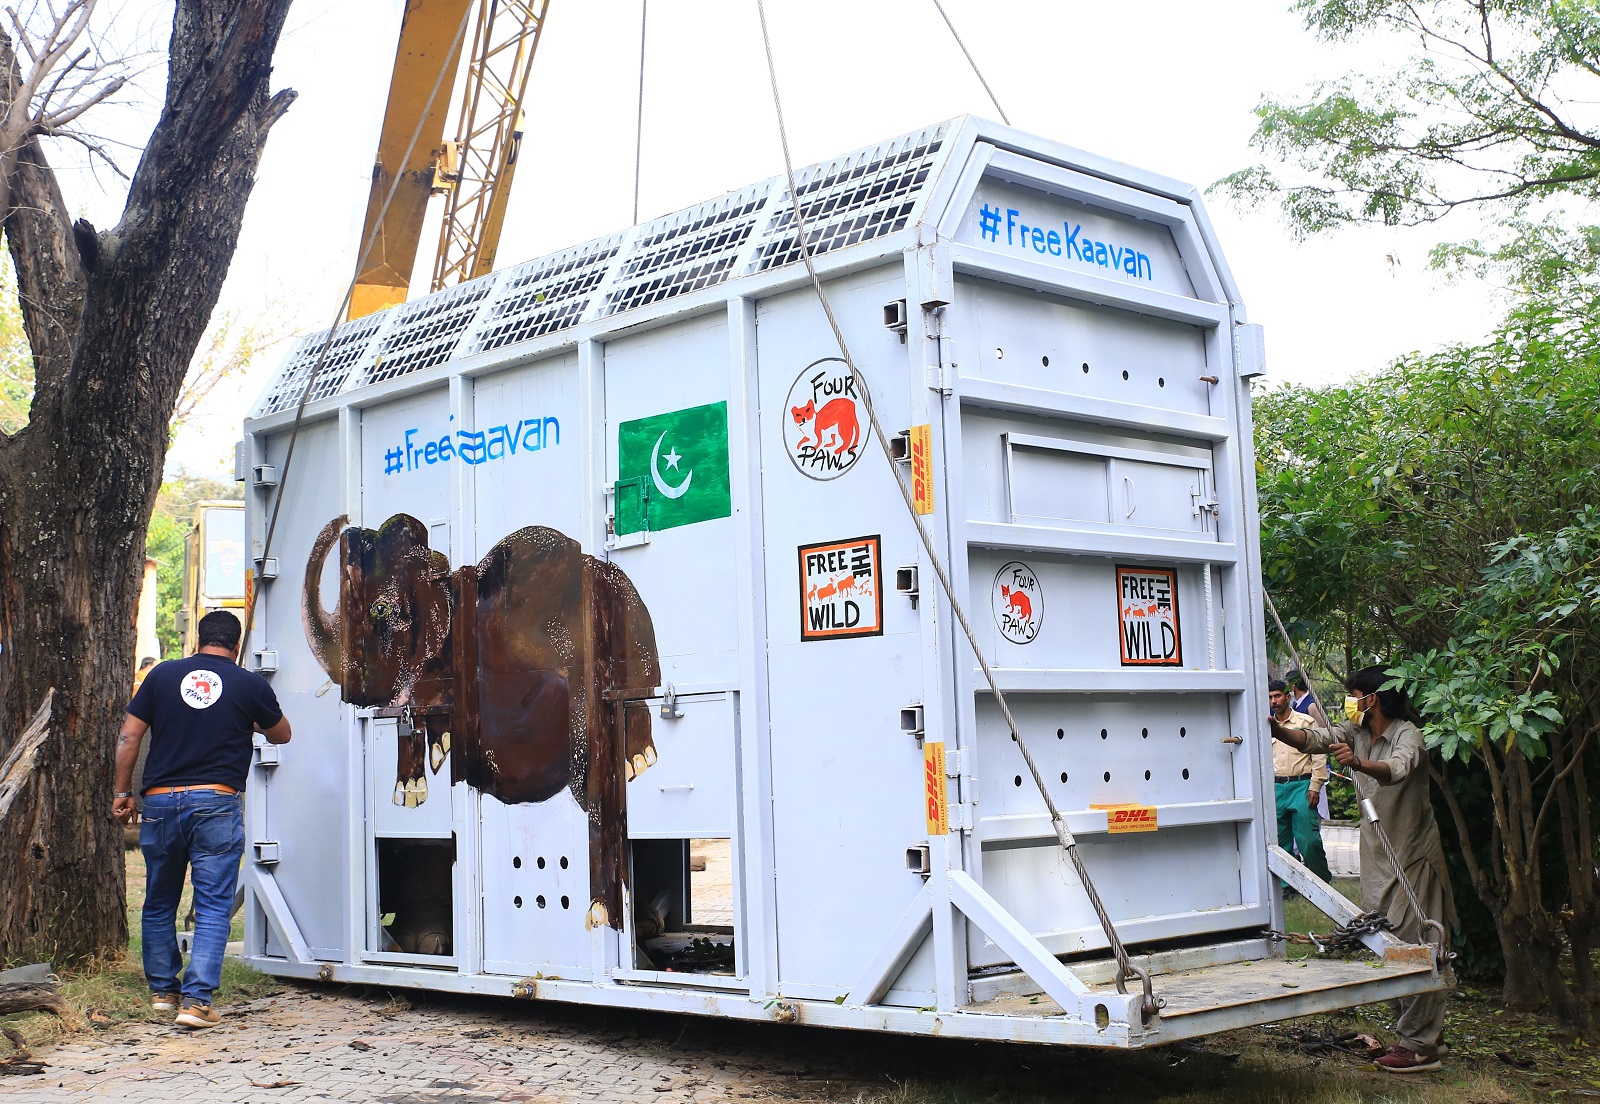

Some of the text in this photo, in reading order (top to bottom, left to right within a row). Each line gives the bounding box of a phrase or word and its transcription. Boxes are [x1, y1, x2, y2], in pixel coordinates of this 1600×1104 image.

[979, 203, 1152, 281] #FreeKaavan
[810, 371, 858, 404] FOUR
[384, 414, 560, 475] #Freeaavan
[797, 445, 859, 471] PAWS
[913, 437, 926, 502] DHL
[807, 550, 848, 577] FREE
[851, 543, 872, 579] THE
[1012, 568, 1035, 591] FOUR
[1122, 576, 1155, 599] FREE
[1156, 575, 1171, 611] THE
[809, 600, 860, 630] WILD
[1002, 613, 1035, 639] PAWS
[1122, 620, 1176, 659] WILD
[199, 673, 219, 688] FOUR
[185, 688, 211, 704] PAWS
[926, 755, 939, 821] DHL
[1114, 809, 1151, 823] DHL
